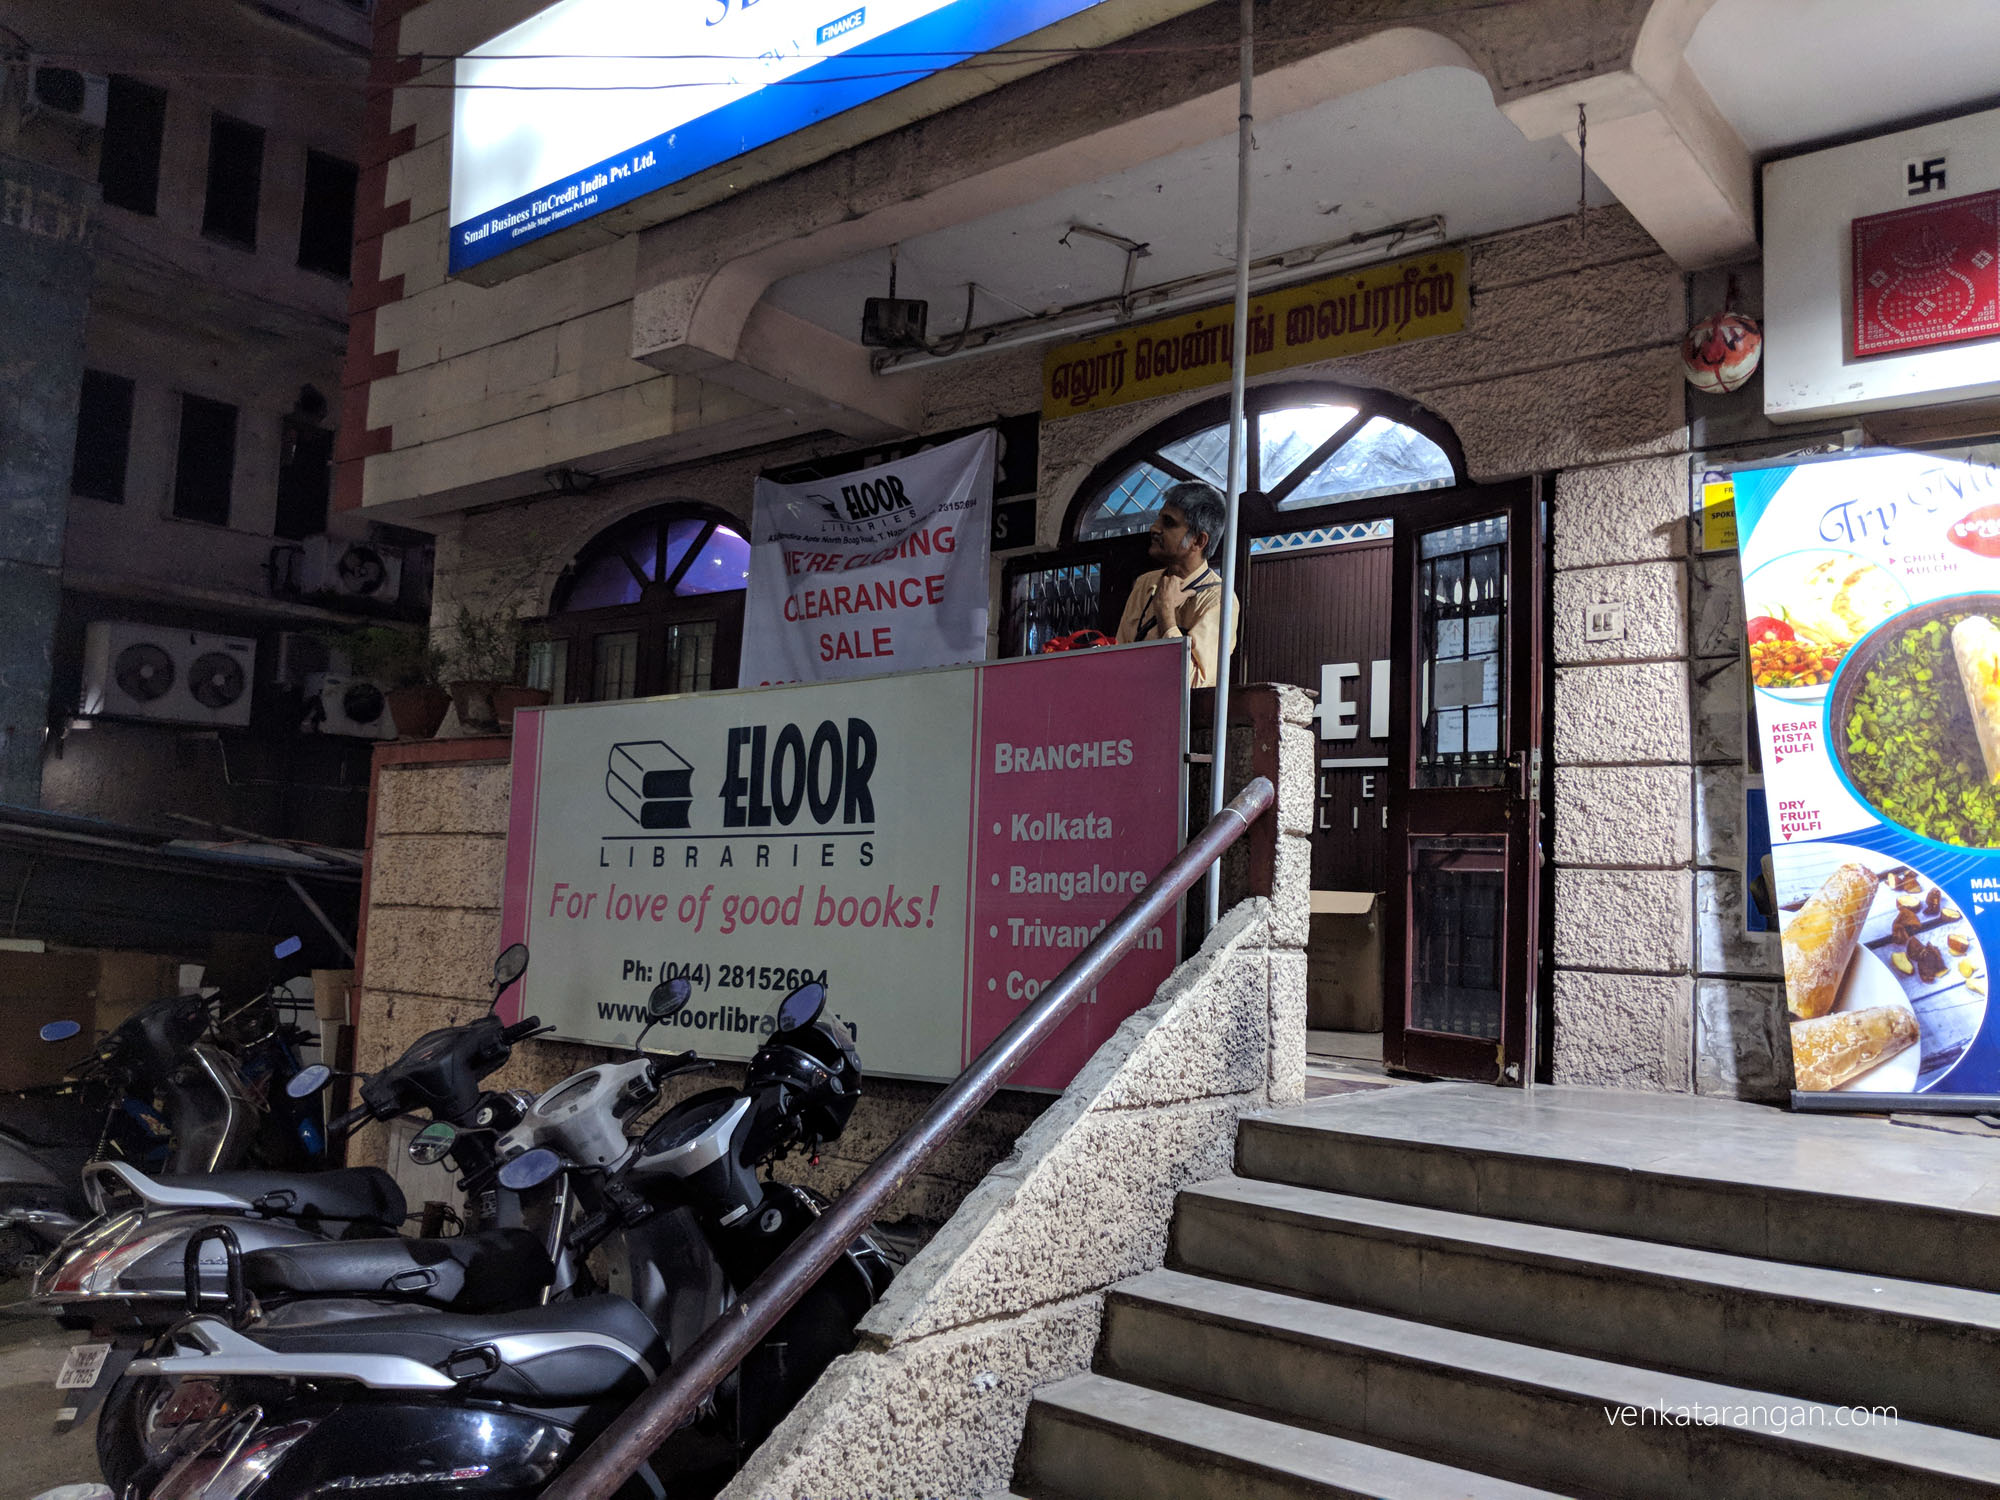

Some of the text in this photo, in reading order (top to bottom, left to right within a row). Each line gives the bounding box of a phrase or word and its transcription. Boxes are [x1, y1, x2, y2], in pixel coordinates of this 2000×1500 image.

[822, 12, 862, 40] FINANCE
[464, 151, 657, 245] Small Business FinCredit India Pvt. Ltd.
[841, 475, 912, 521] ELOOR
[784, 574, 945, 622] CLEARANCE
[820, 627, 894, 662] SALE
[1771, 720, 1817, 733] KESAR
[1773, 732, 1812, 744] PISTA
[1774, 743, 1814, 754] KULFI
[718, 717, 878, 828] ELOOR
[1779, 800, 1806, 811] DRY
[1780, 810, 1820, 821] FRUIT
[1011, 811, 1113, 842] Kolkata
[1781, 821, 1822, 832] KULFI
[600, 841, 875, 868] LIBRARIES
[1009, 864, 1148, 902] Bangalore
[549, 882, 940, 934] For love of good books!
[622, 959, 653, 982] Ph:
